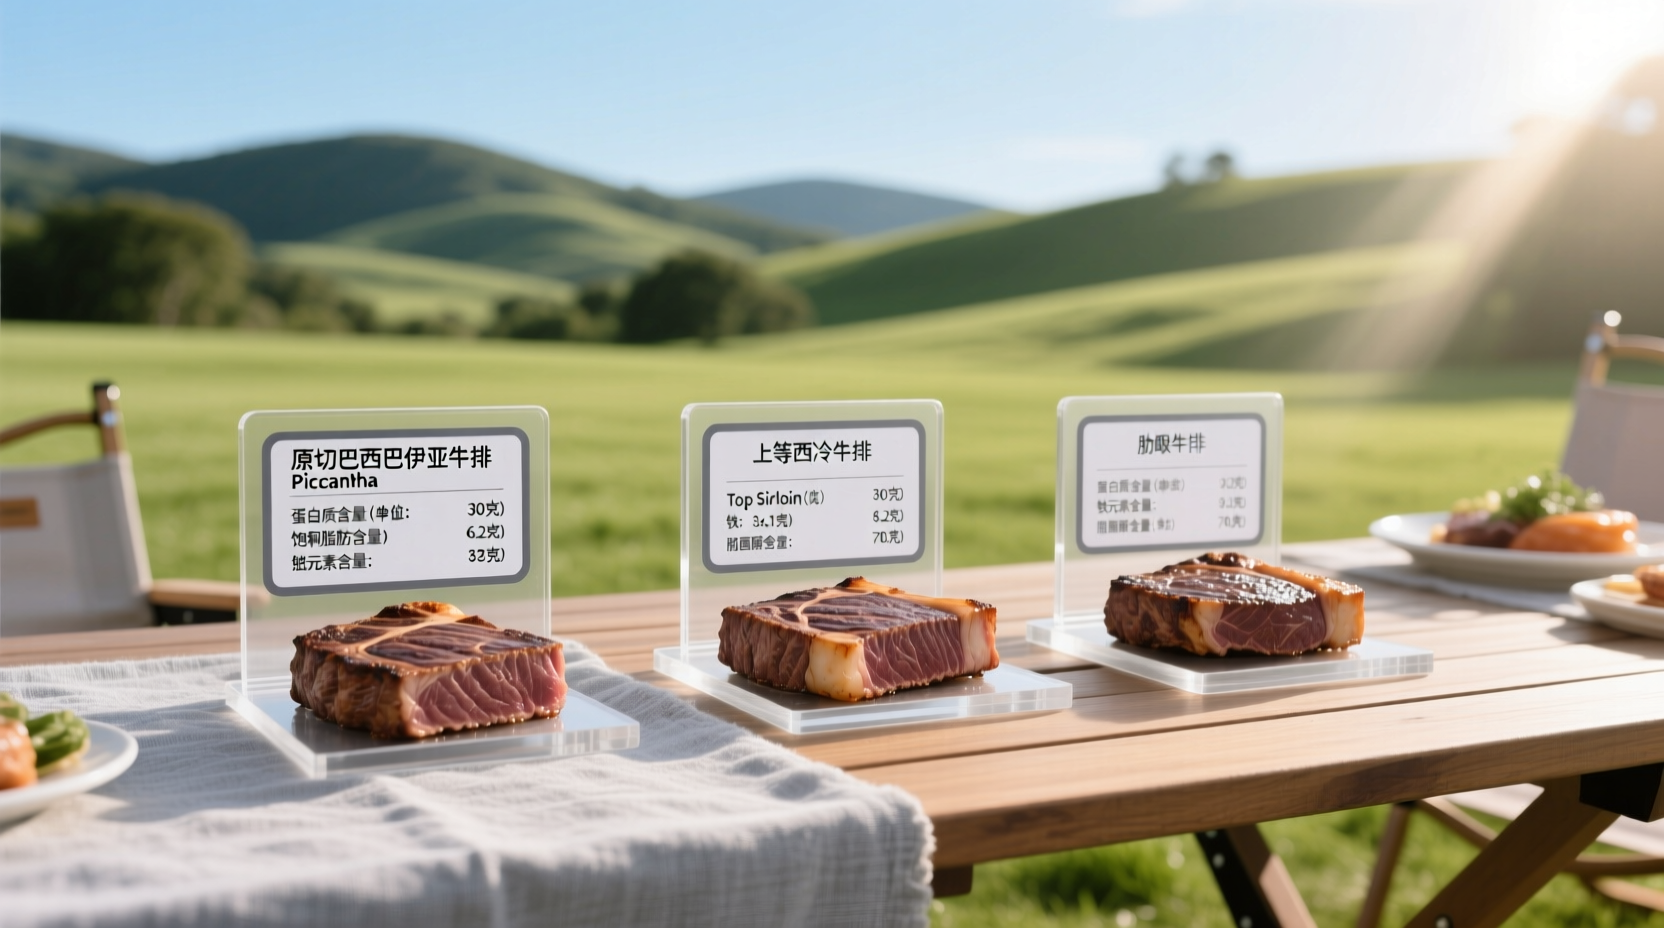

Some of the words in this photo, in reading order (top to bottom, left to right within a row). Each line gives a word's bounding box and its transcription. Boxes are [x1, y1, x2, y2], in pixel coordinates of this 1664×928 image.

[291, 445, 492, 471] 原切巴西巴伊亚牛排
[753, 440, 872, 464] 上等西冷牛排
[467, 500, 505, 517] 30克)
[727, 492, 753, 510] Top
